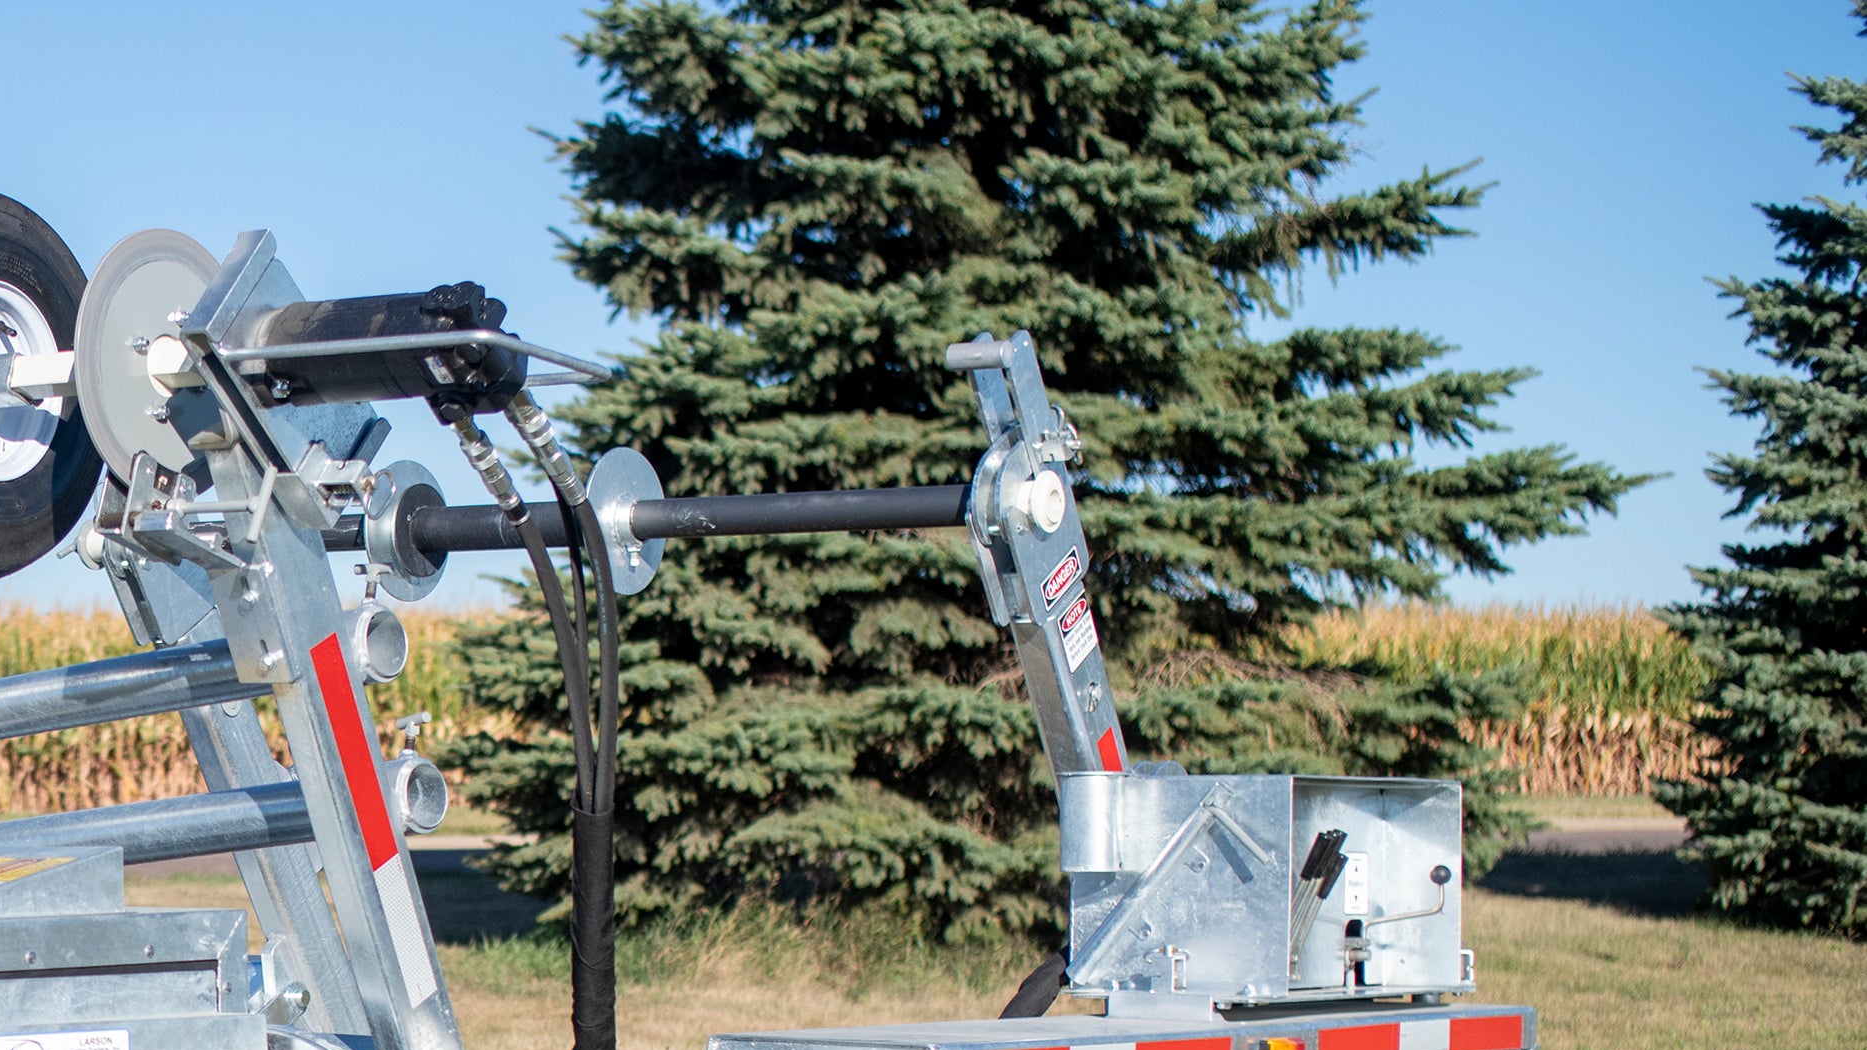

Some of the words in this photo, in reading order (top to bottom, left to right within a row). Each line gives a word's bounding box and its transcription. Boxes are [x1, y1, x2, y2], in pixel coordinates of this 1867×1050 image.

[1046, 562, 1075, 595] DANGER
[1065, 603, 1083, 627] NOTE
[79, 1037, 113, 1047] LARSON
